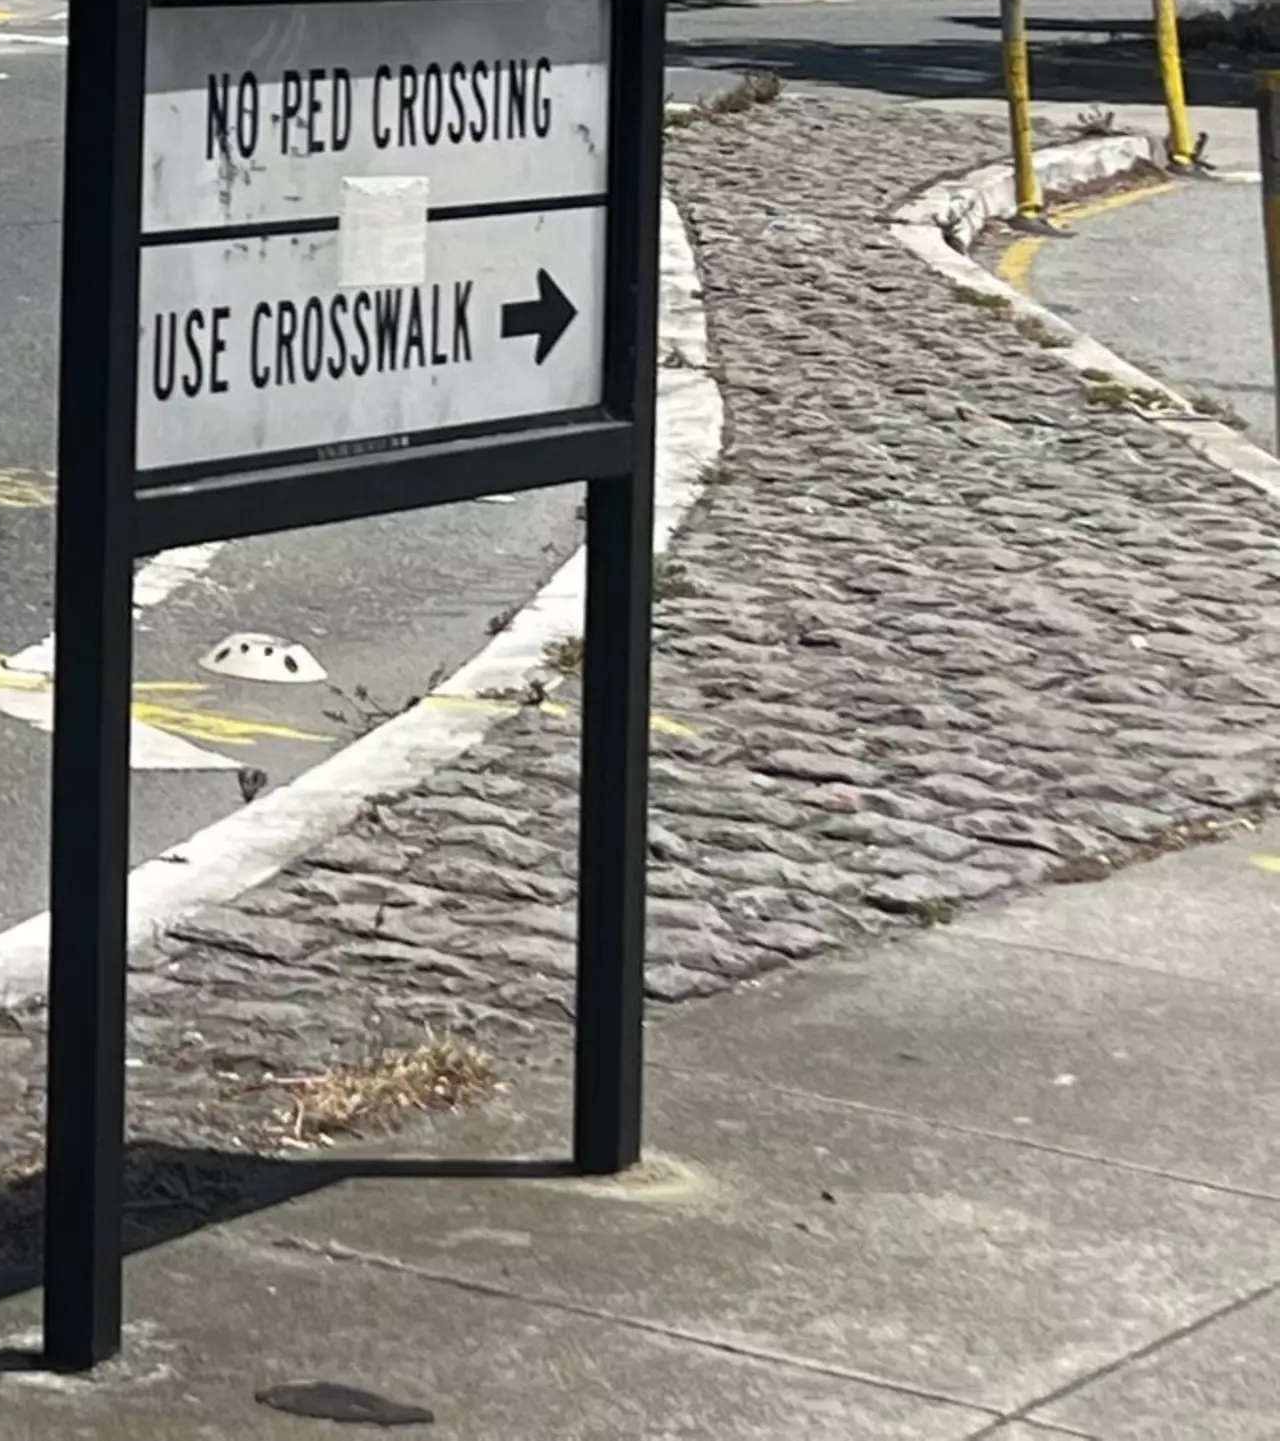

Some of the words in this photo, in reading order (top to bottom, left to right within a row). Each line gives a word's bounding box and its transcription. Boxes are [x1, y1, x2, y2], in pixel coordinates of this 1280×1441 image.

[207, 71, 259, 160] NO
[281, 68, 352, 154] PED
[373, 56, 552, 149] CROSSING
[154, 307, 231, 401] USE
[251, 282, 473, 389] CROSSWALK
